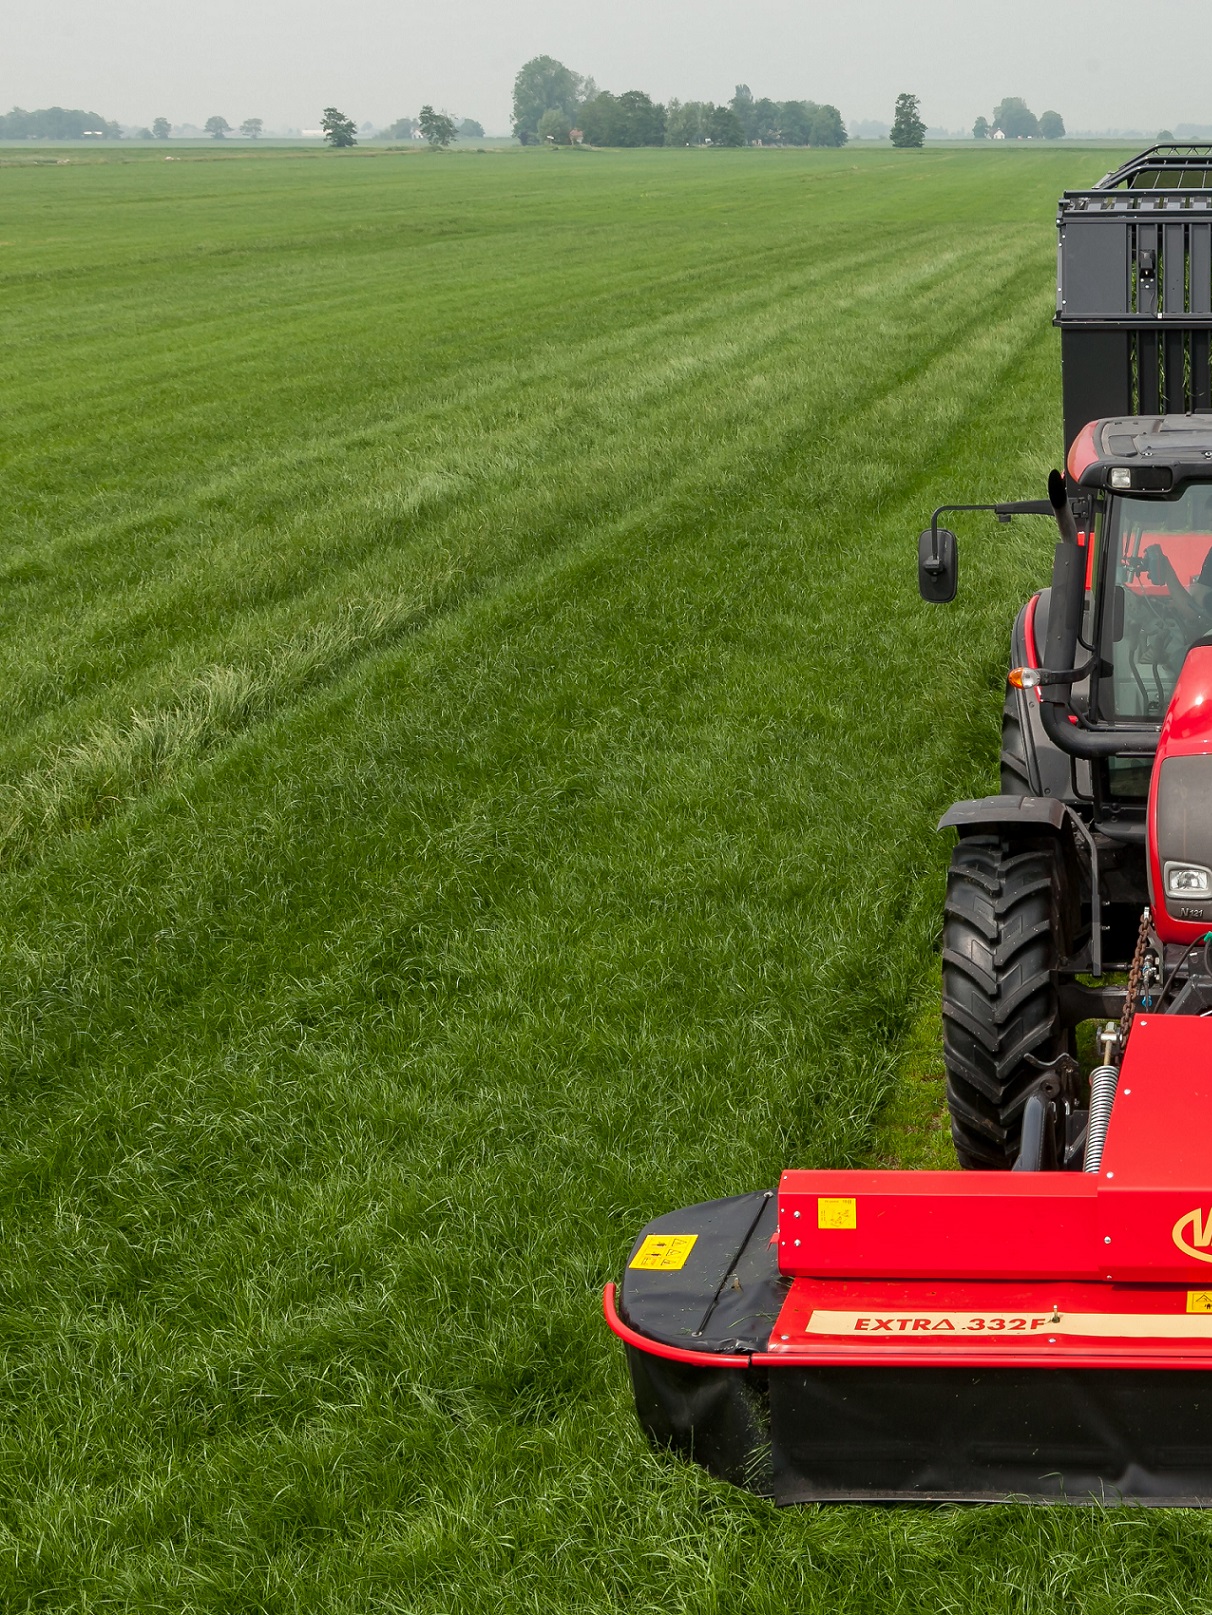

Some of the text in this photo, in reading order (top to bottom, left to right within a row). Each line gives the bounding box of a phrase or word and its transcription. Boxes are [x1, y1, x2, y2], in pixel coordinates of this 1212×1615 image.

[1180, 907, 1204, 918] N121
[854, 1318, 1046, 1331] EXTRA 332F
